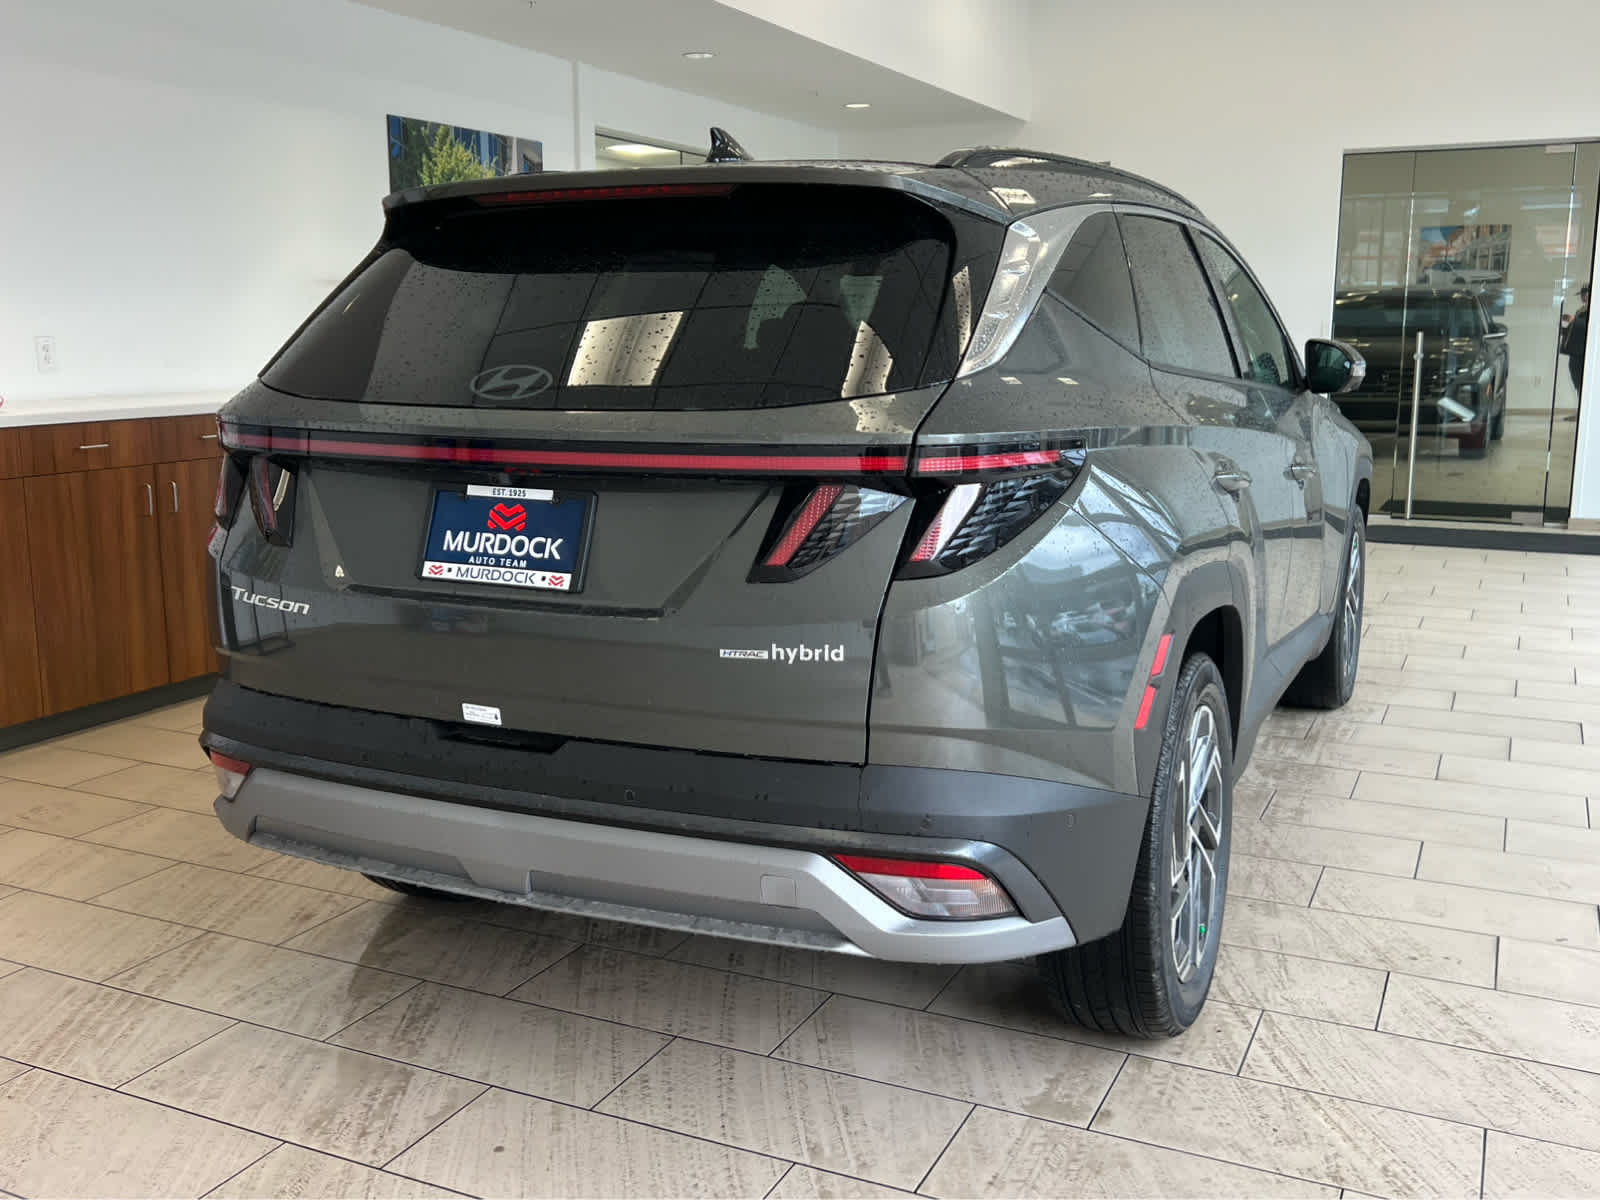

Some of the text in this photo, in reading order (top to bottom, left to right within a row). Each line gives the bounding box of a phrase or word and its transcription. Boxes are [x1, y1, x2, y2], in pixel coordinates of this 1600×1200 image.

[508, 488, 527, 498] 1925
[442, 530, 564, 560] MURDOCK
[468, 556, 528, 568] AUTO TEAM
[455, 566, 536, 585] MURDOCK
[771, 643, 844, 664] hybrid
